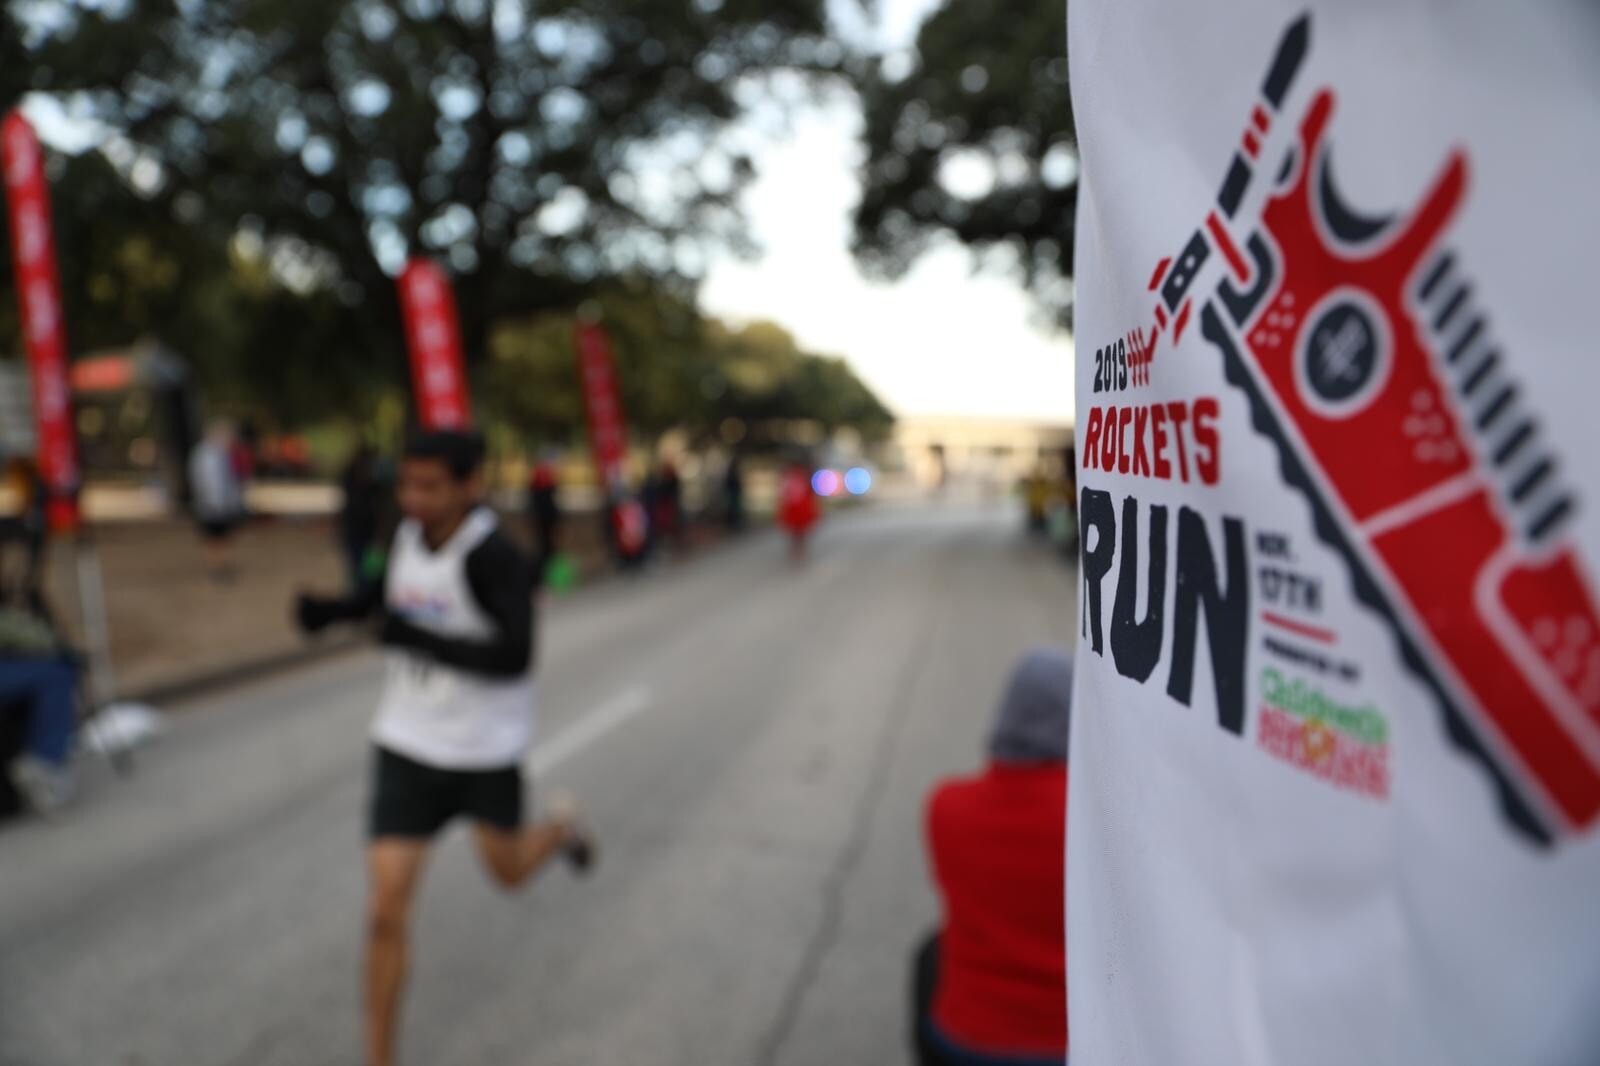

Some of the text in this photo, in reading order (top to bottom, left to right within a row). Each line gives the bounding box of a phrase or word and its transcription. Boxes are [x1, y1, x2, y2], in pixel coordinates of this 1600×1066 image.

[1094, 338, 1127, 393] 2019
[1083, 397, 1219, 486] ROCKETS
[1081, 486, 1248, 737] RUN
